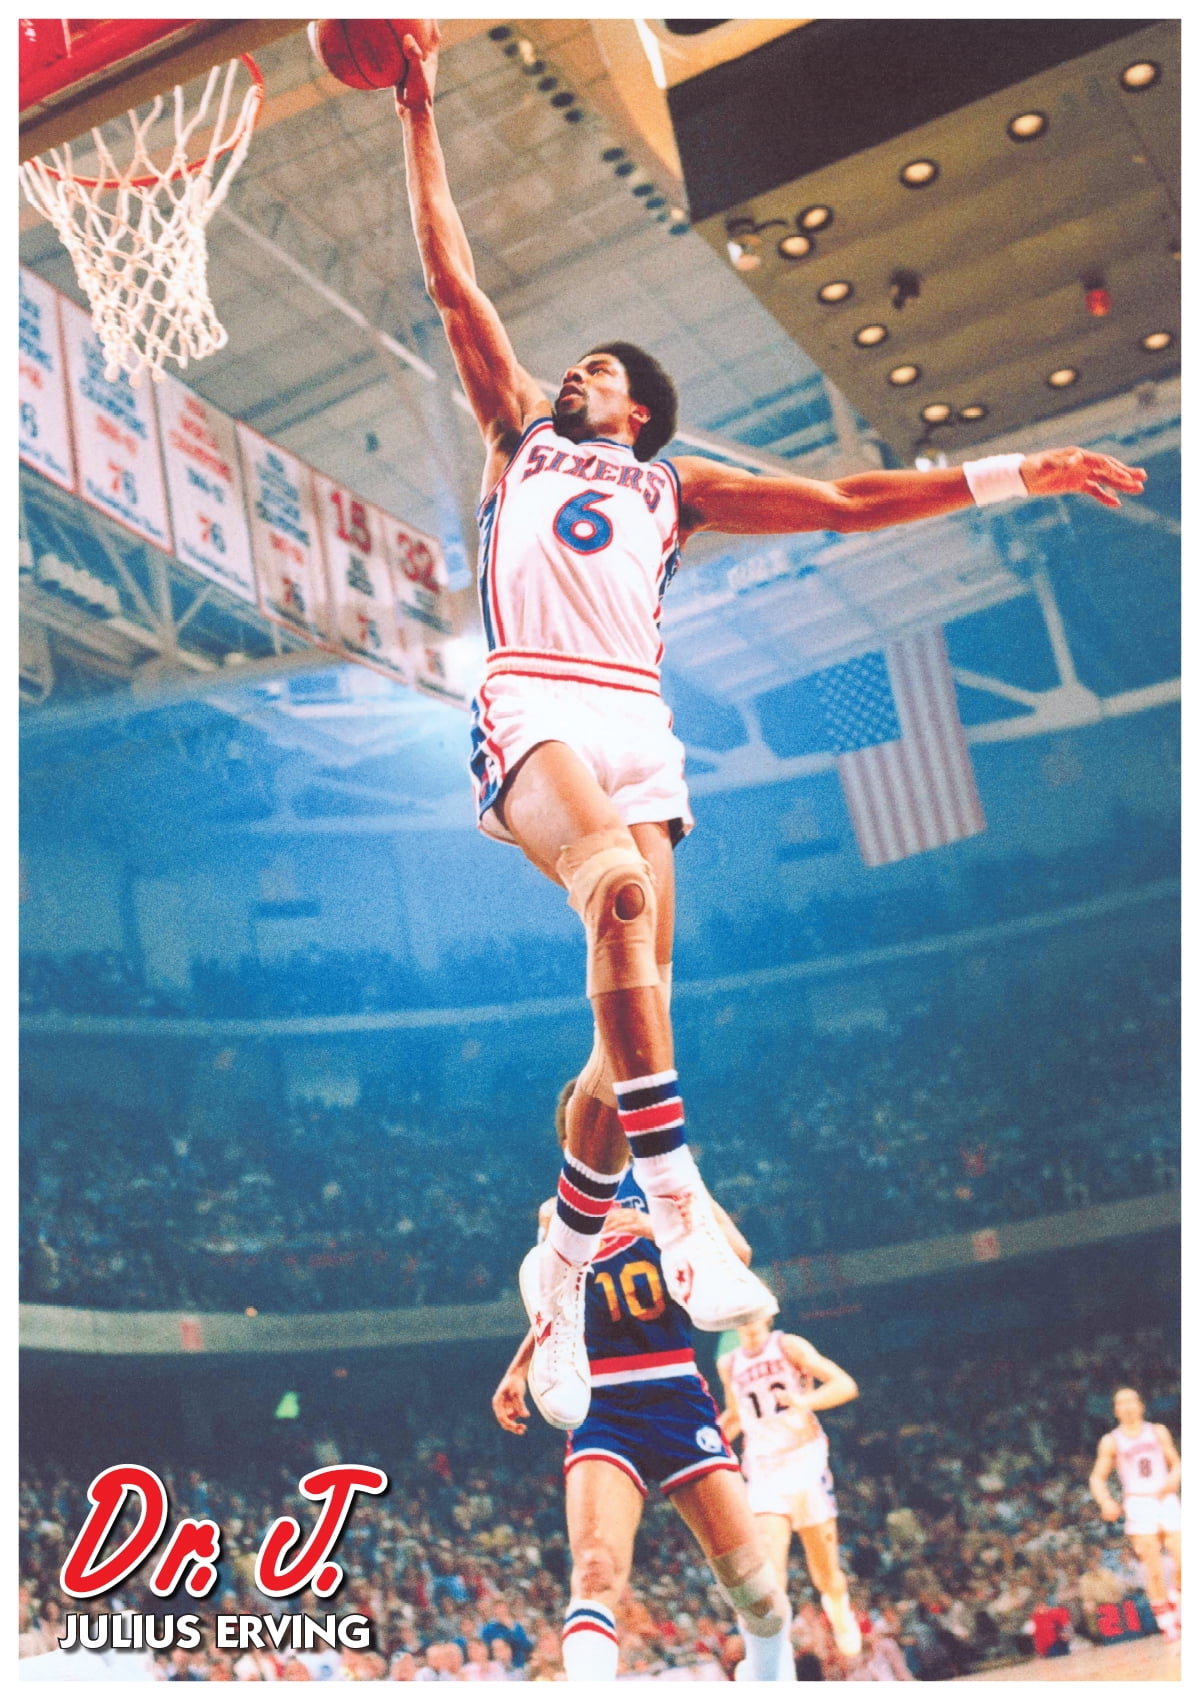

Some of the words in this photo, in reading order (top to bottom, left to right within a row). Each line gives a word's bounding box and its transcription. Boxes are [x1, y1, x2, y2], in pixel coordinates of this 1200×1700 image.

[107, 459, 138, 504] 76
[520, 444, 666, 514] SIXERS
[197, 510, 227, 554] 76
[330, 490, 372, 554] 15
[552, 488, 614, 556] 6
[397, 531, 441, 595] 32
[594, 1259, 666, 1323] 10
